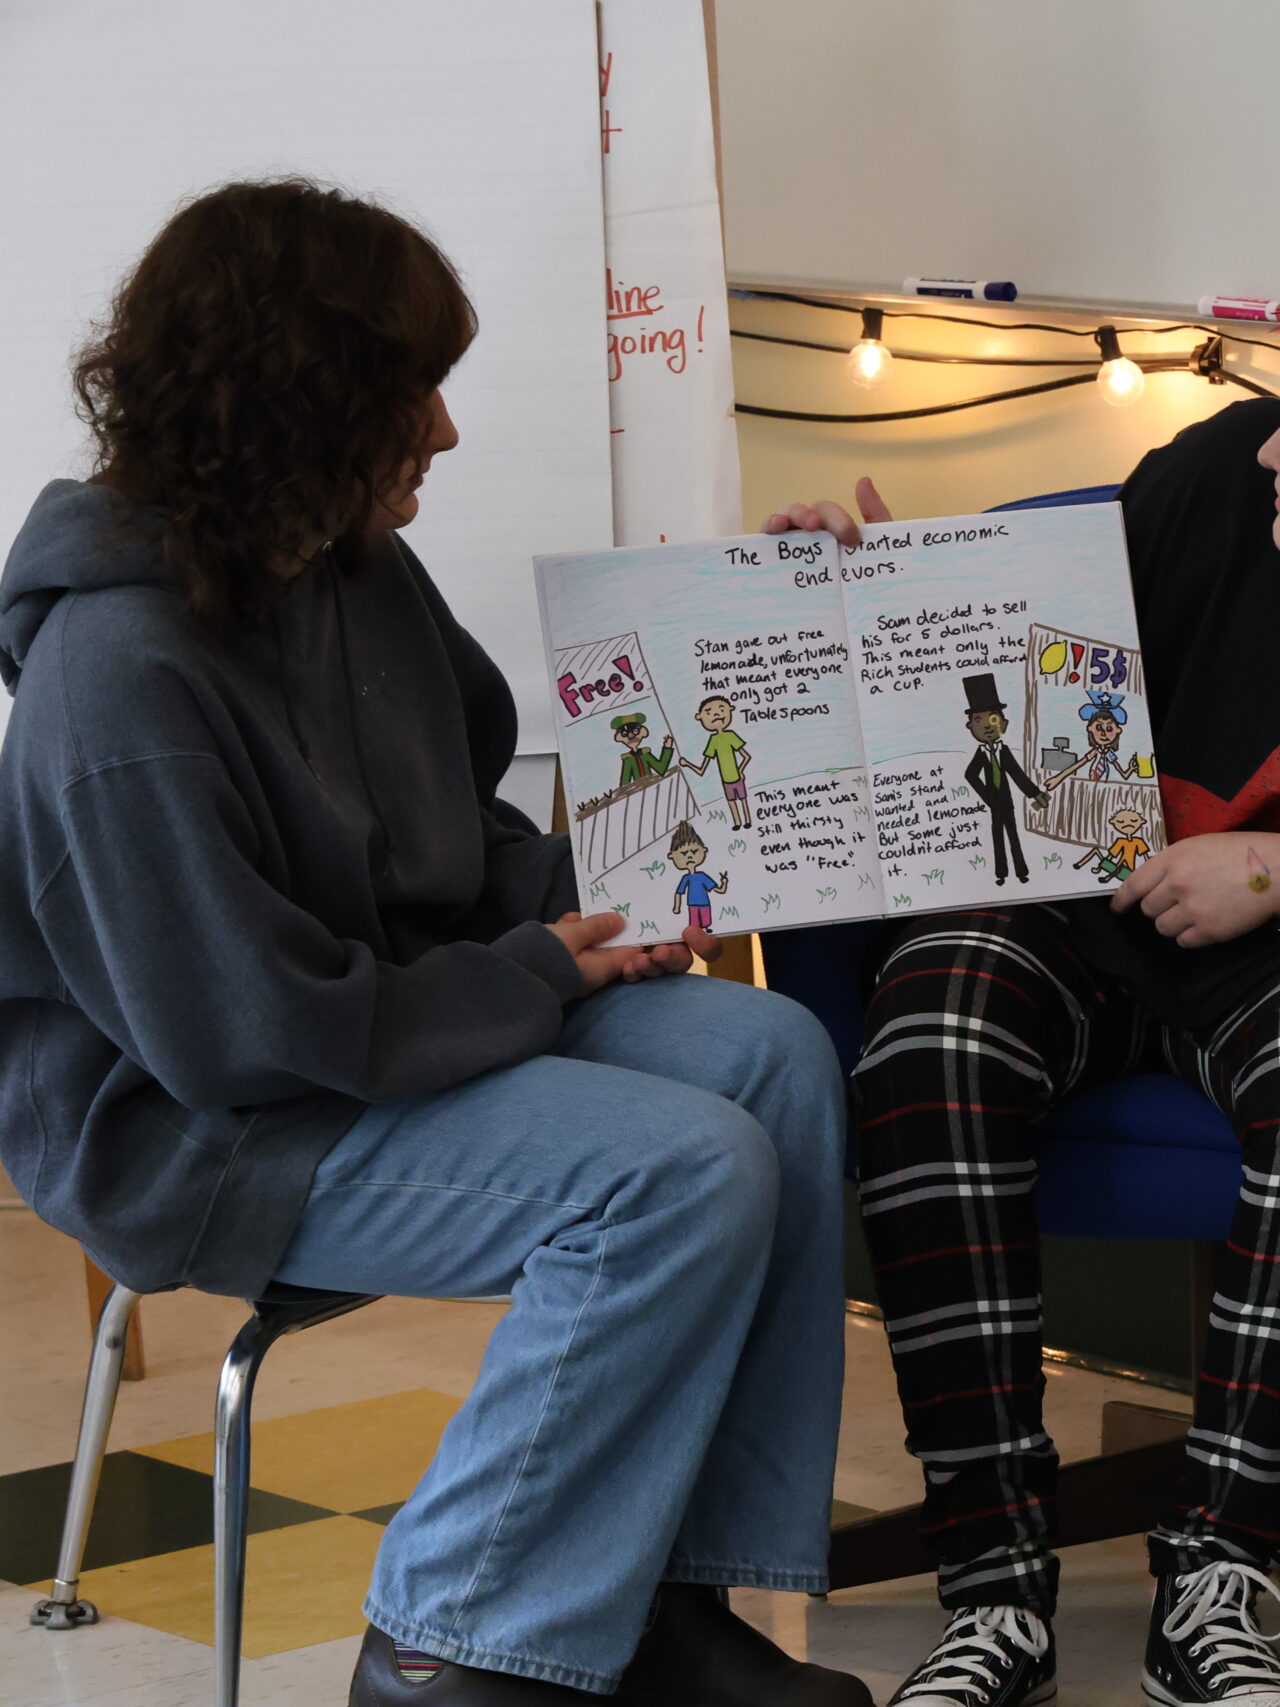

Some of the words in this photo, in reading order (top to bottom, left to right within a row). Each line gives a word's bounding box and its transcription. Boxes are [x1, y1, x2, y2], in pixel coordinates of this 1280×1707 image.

[725, 547, 761, 566] The
[778, 541, 823, 564] Boys
[922, 524, 1009, 547] economic
[877, 615, 910, 631] Sam
[916, 604, 973, 625] decided
[982, 604, 997, 615] to
[1003, 600, 1027, 614] sell
[694, 639, 729, 657] Stan
[735, 636, 763, 654] gave
[767, 633, 788, 645] out
[862, 635, 882, 649] his
[891, 632, 911, 644] for
[921, 628, 931, 640] 5
[862, 651, 892, 665] This
[900, 645, 946, 659] meant
[956, 640, 989, 655] only
[998, 636, 1026, 648] the
[770, 642, 848, 666] unfortunately
[702, 677, 730, 691] that
[736, 671, 777, 685] meant
[785, 663, 843, 680] everyone
[861, 666, 894, 682] Rich
[956, 657, 989, 668] could
[992, 654, 1027, 664] afford
[1090, 647, 1128, 689] 5$
[557, 654, 644, 718] Free!
[730, 687, 761, 705] only
[764, 683, 788, 702] got
[797, 682, 811, 694] 2
[870, 685, 883, 695] a
[873, 771, 922, 787] Everyone
[930, 765, 944, 777] at
[754, 789, 786, 803] This
[792, 780, 840, 797] meant
[756, 799, 821, 820] everyone
[828, 792, 859, 805] was
[875, 800, 915, 817] wanted
[925, 795, 949, 807] and
[877, 813, 920, 832] needed
[927, 801, 988, 822] lemonade
[790, 815, 844, 831] thirsty
[878, 832, 899, 846] But
[949, 820, 980, 839] just
[760, 842, 791, 856] even
[798, 835, 846, 850] though
[852, 832, 866, 843] it
[935, 837, 983, 853] afford
[765, 861, 798, 873] was
[887, 863, 907, 877] it.
